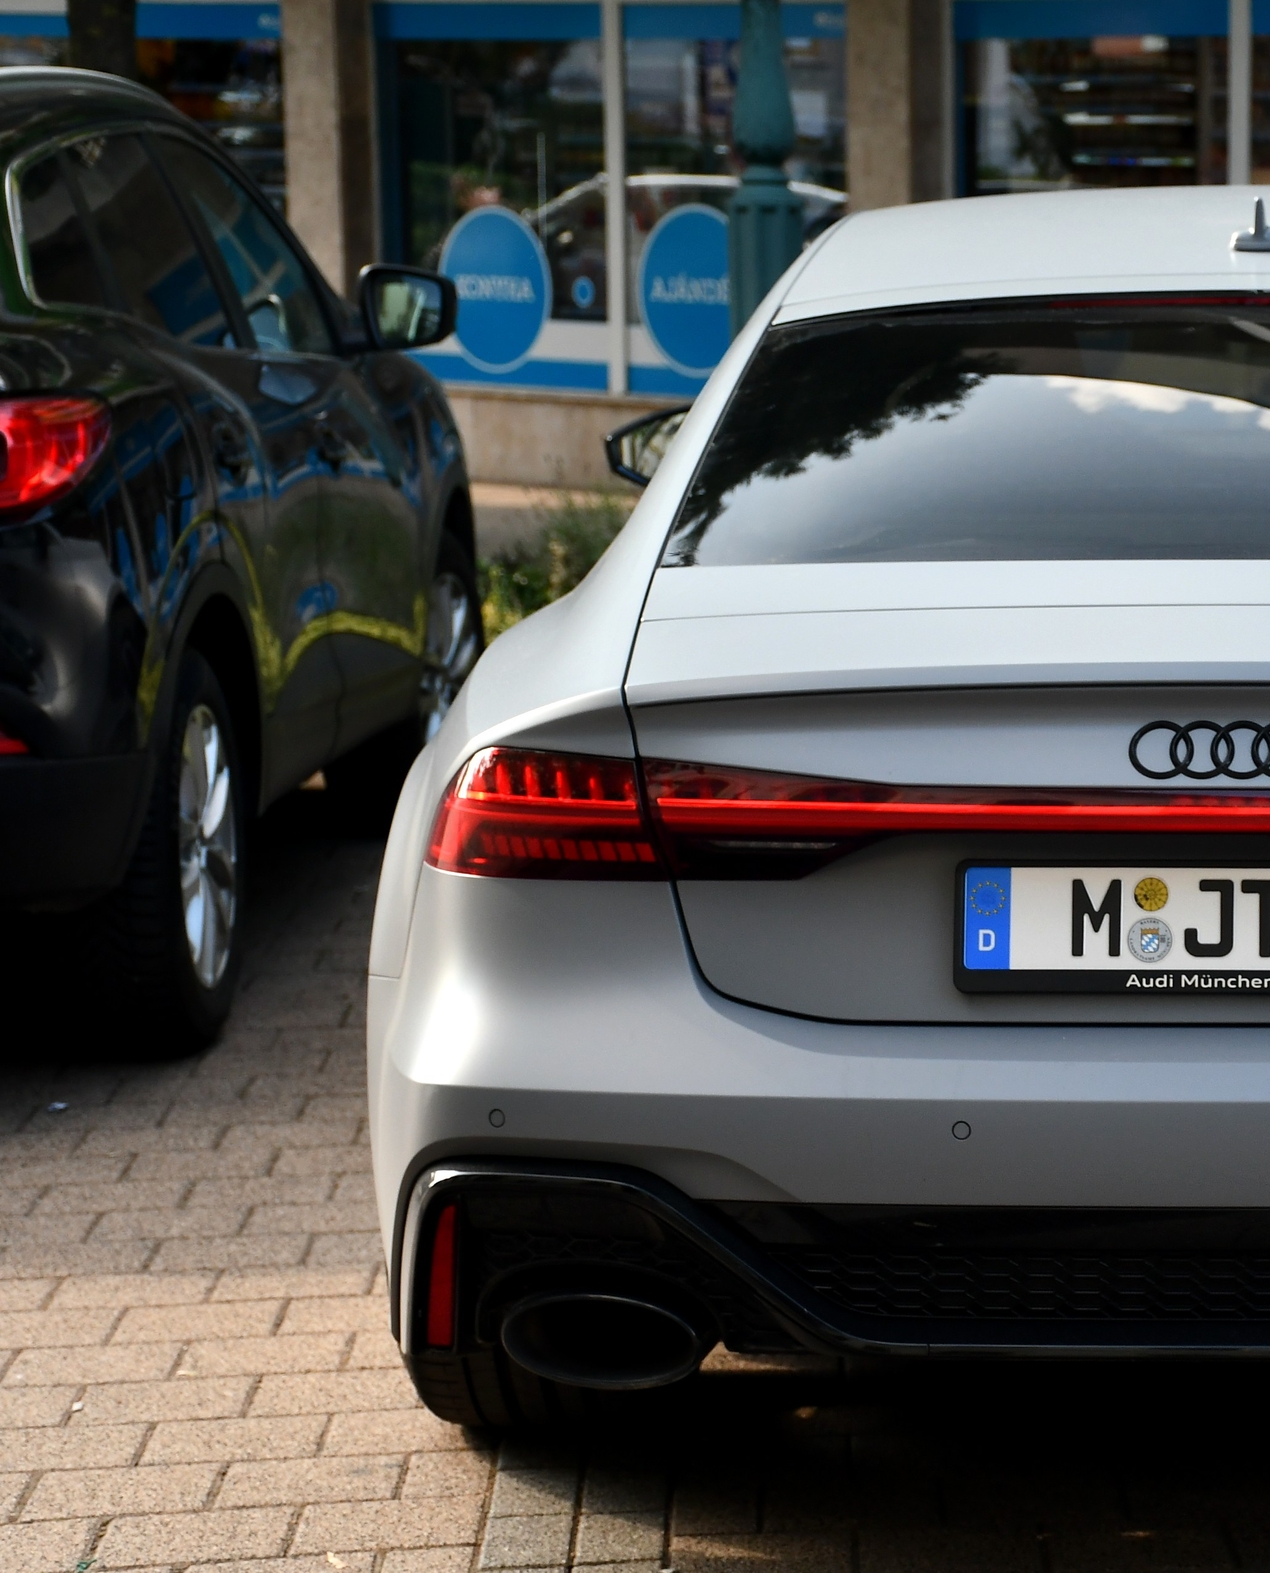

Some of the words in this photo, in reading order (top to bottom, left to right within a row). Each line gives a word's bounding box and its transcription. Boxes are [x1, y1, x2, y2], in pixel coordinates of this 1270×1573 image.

[1071, 879, 1122, 957] M
[978, 930, 995, 951] D
[1125, 974, 1174, 989] Audi
